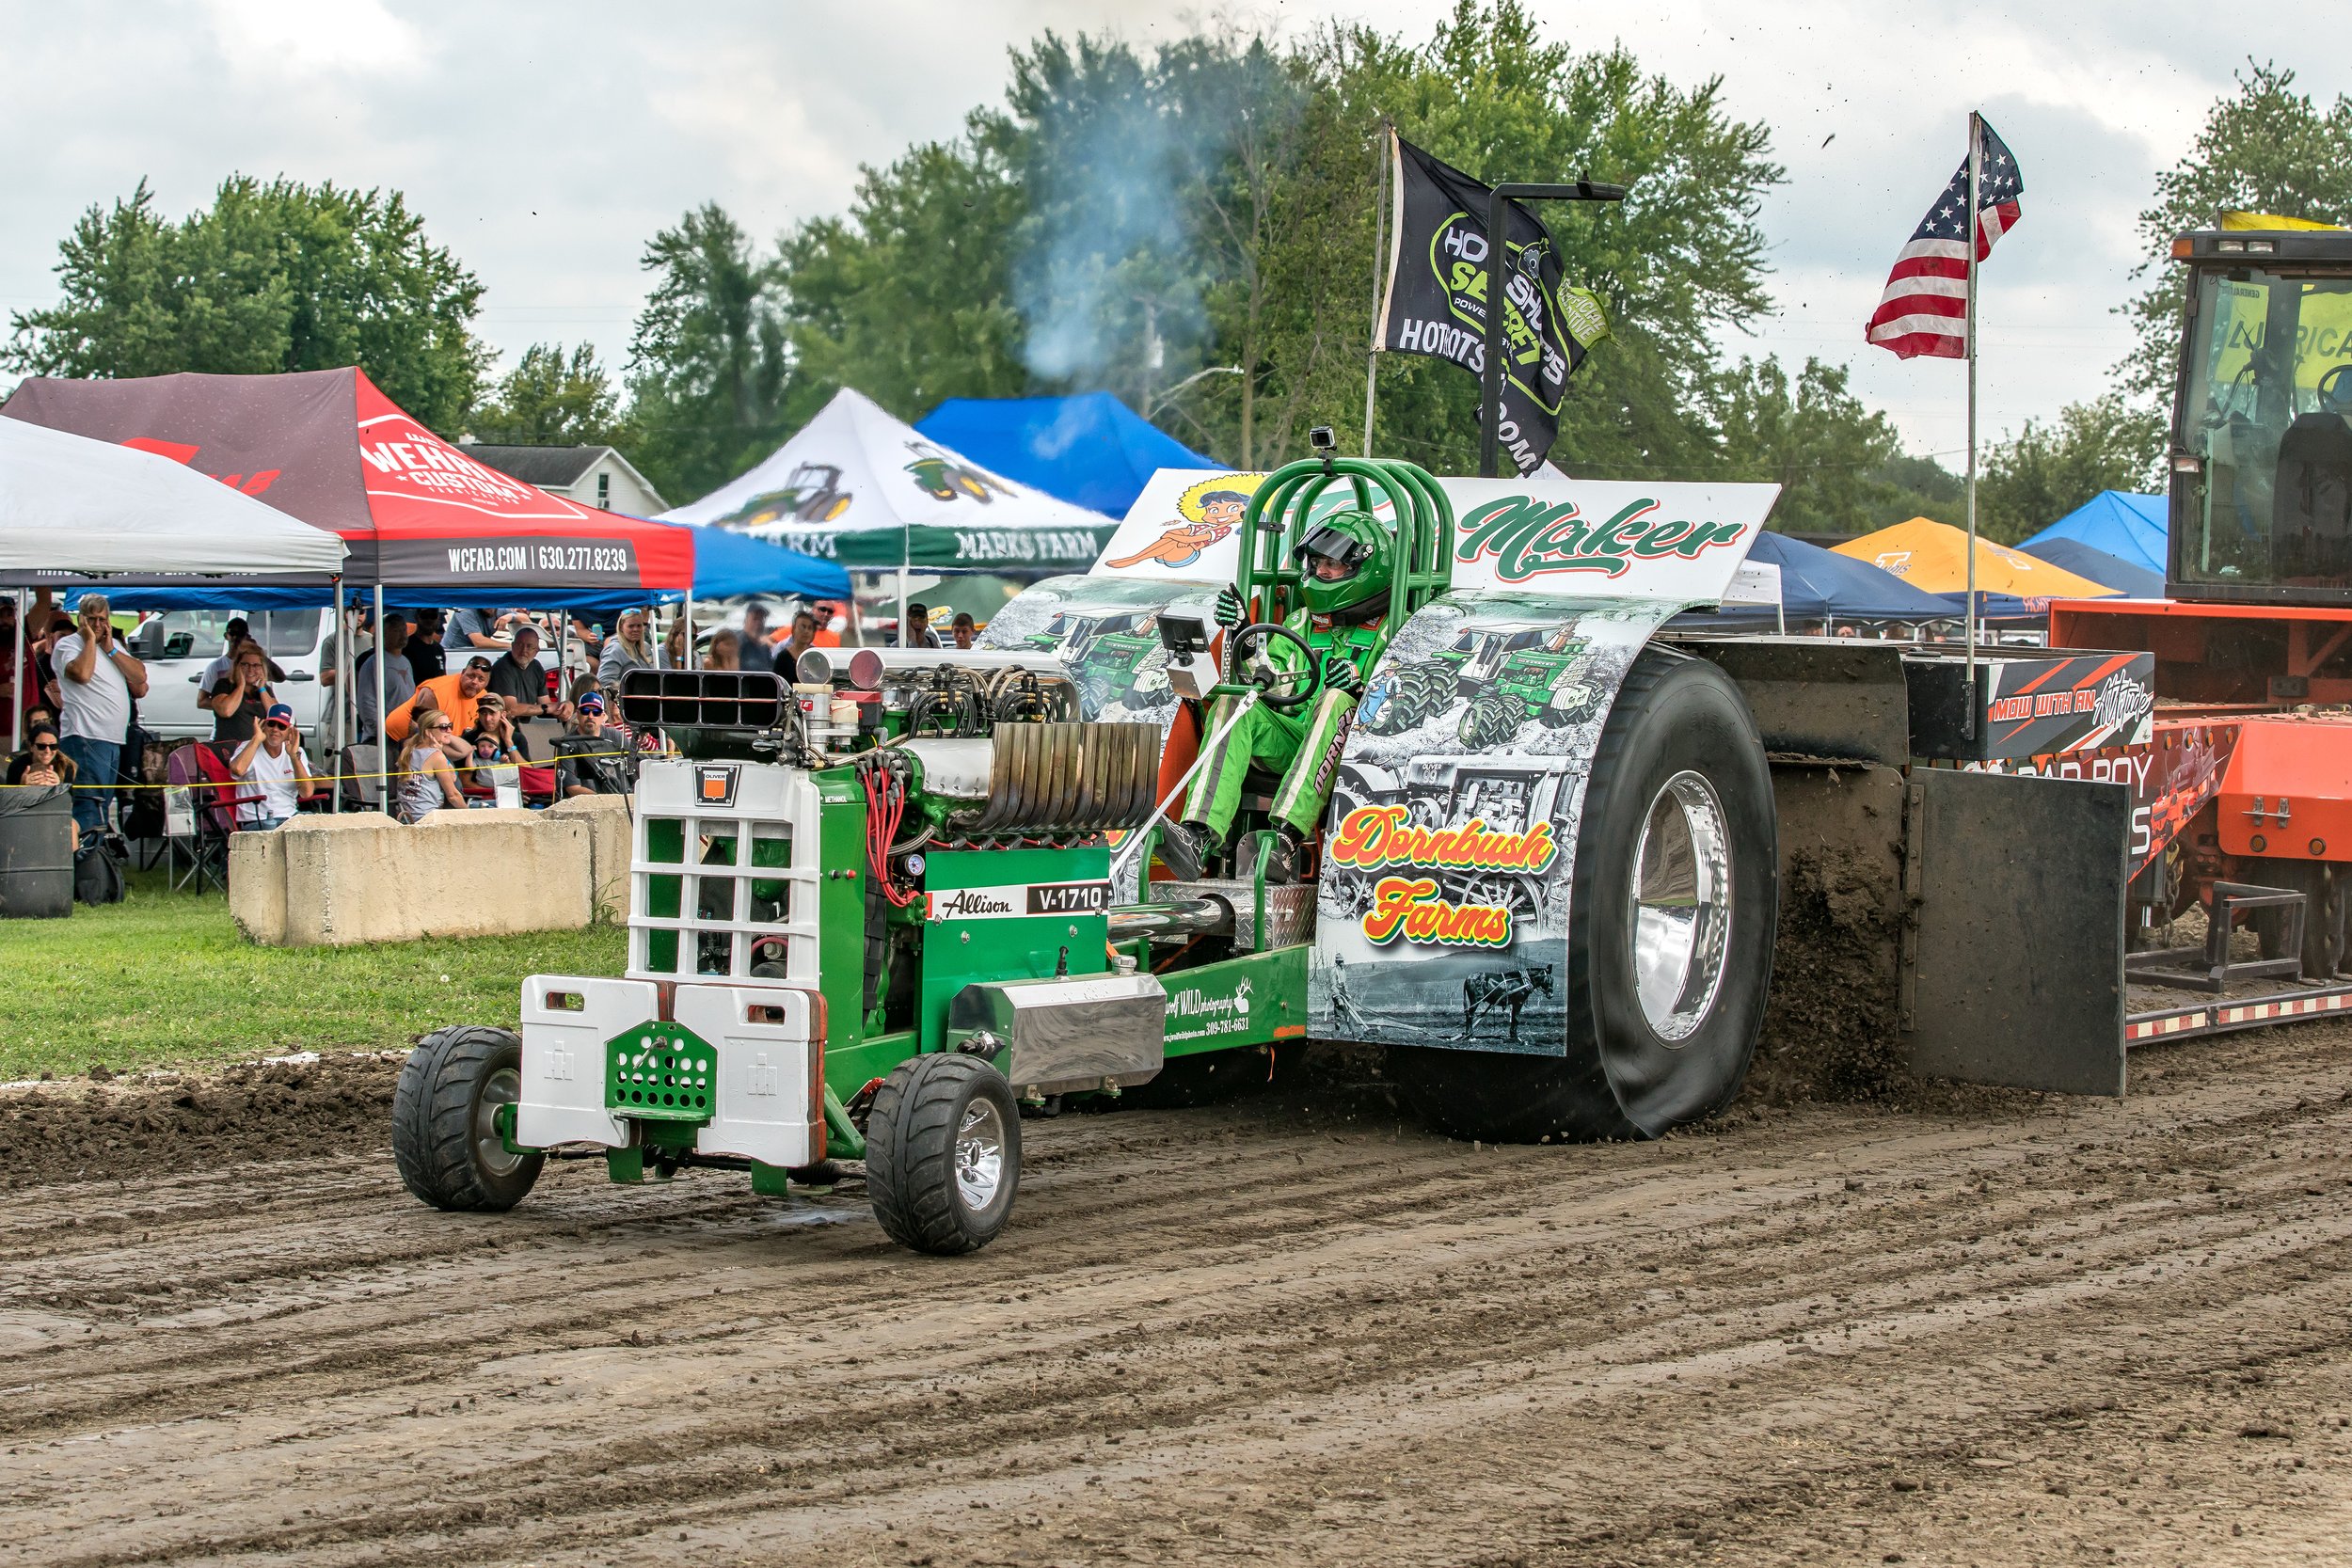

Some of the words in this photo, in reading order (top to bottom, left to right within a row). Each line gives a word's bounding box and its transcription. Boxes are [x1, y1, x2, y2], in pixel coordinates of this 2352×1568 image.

[1444, 226, 1488, 263] HO
[1454, 297, 1486, 319] POWE
[408, 471, 519, 500] CUSTOM
[954, 531, 1035, 560] MARKS
[1035, 531, 1098, 559] FARM
[1455, 494, 1748, 583] Maker
[448, 546, 527, 573] WCFAB.COM
[538, 546, 628, 572] 630.277.8239
[1994, 696, 2033, 722] MOW
[2035, 692, 2073, 717] WITH
[2074, 689, 2097, 713] AN
[2092, 669, 2151, 732] Attitude
[1330, 804, 1559, 875] Dornbush
[942, 889, 1013, 919] Allison
[1039, 887, 1102, 911] V-1710
[1362, 876, 1514, 949] Farms
[1180, 988, 1201, 1016] WILD
[1205, 1017, 1249, 1037] 309-781-6631
